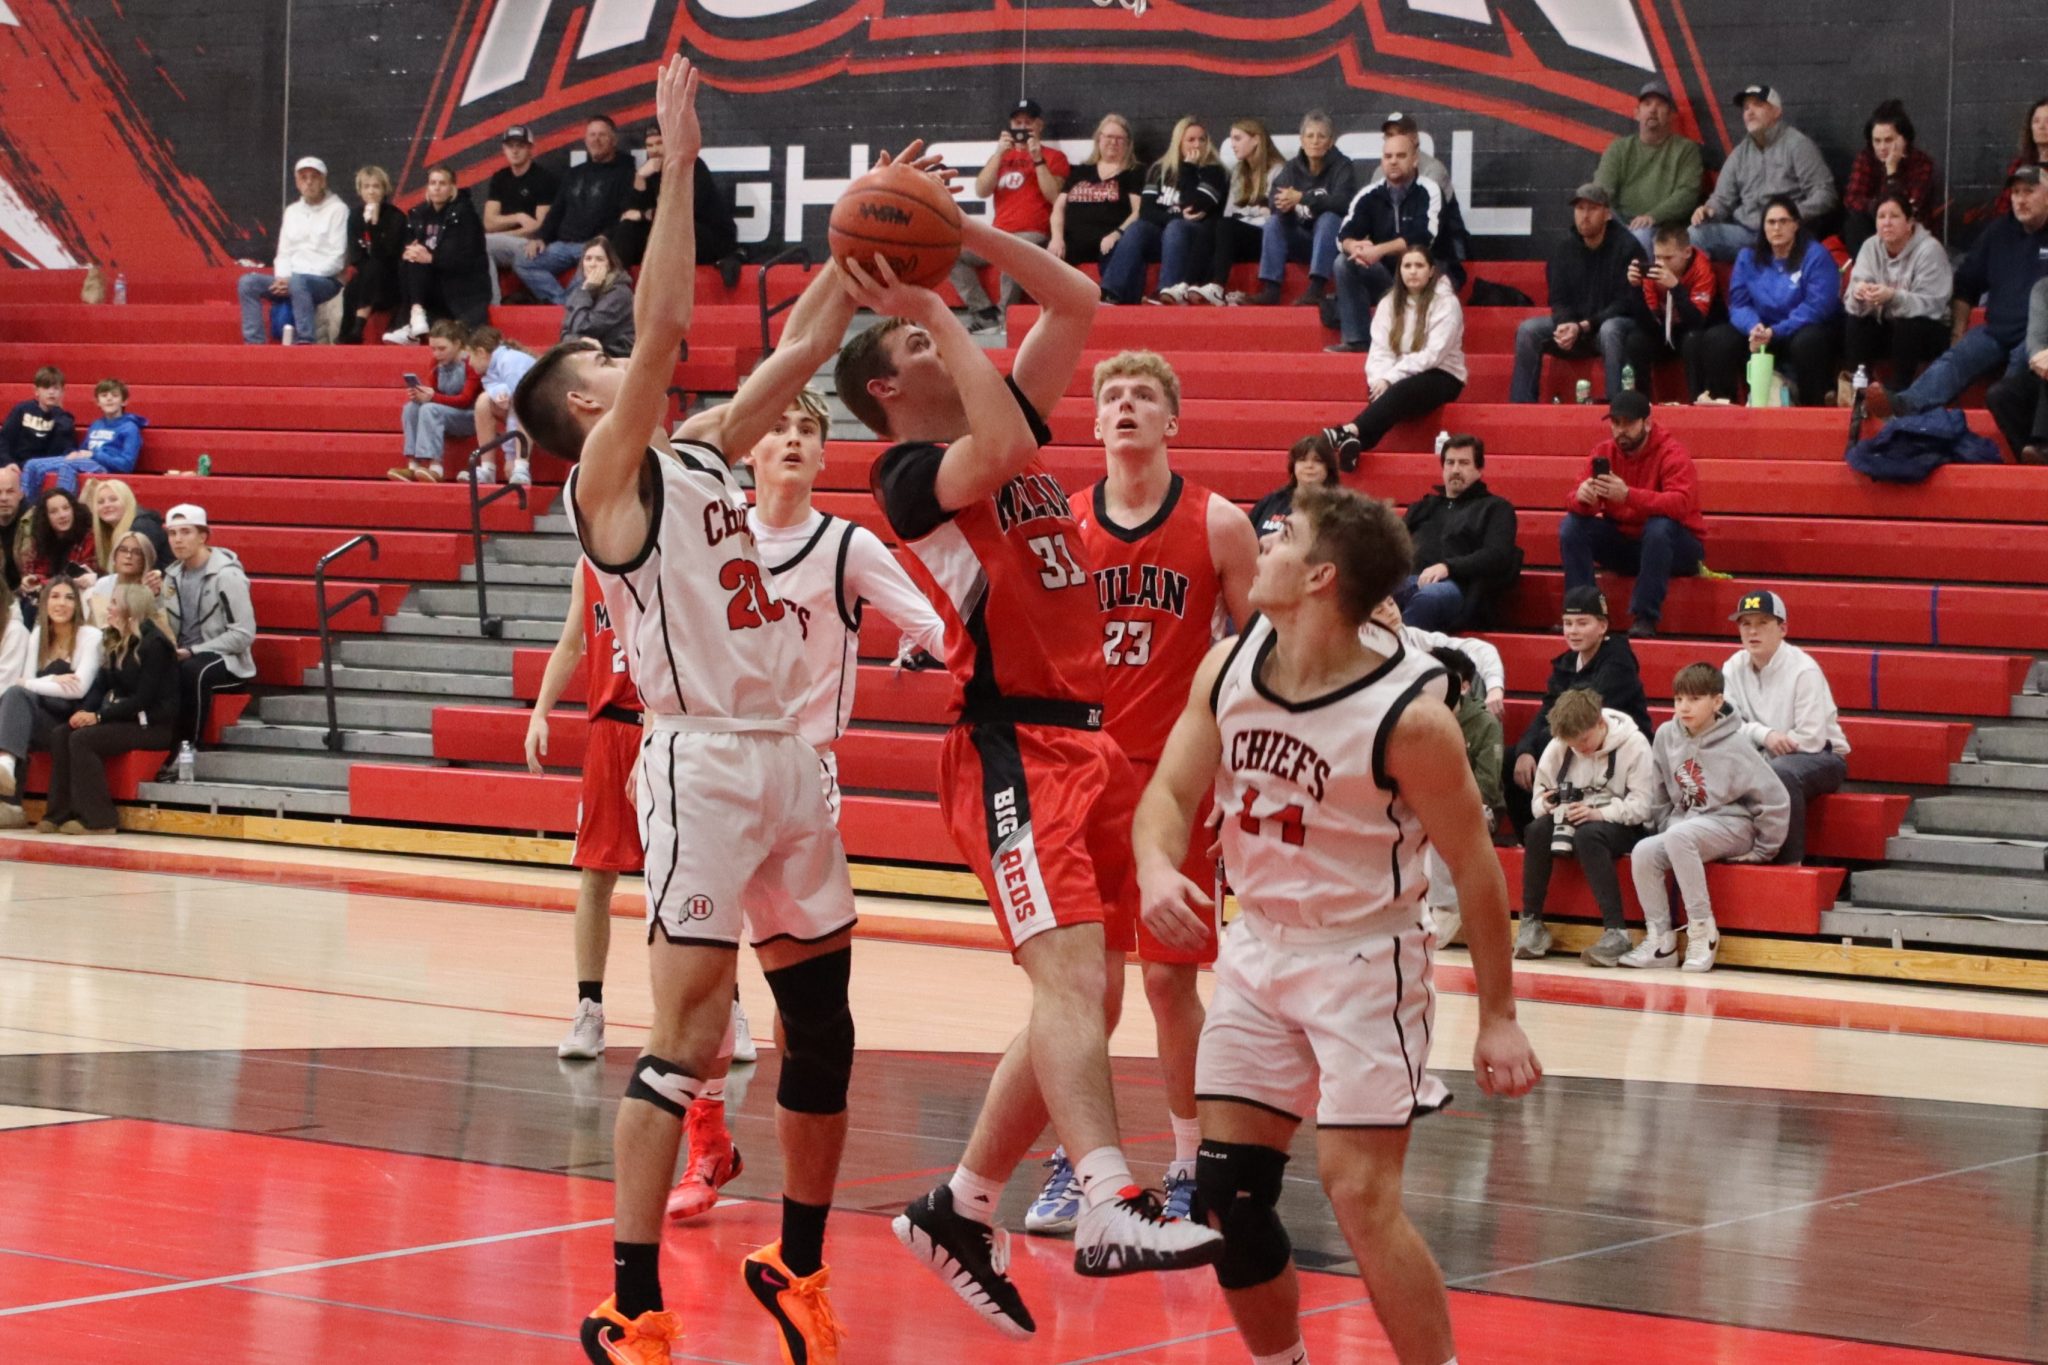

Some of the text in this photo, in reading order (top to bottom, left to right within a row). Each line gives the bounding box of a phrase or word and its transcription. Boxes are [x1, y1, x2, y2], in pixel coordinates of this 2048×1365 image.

[1028, 533, 1086, 590] 31
[1745, 597, 1761, 609] M
[1102, 621, 1153, 666] 23
[1087, 709, 1101, 725] M
[1231, 729, 1331, 804] CHIEFS
[994, 786, 1019, 838] BIG
[1000, 847, 1036, 923] REDS
